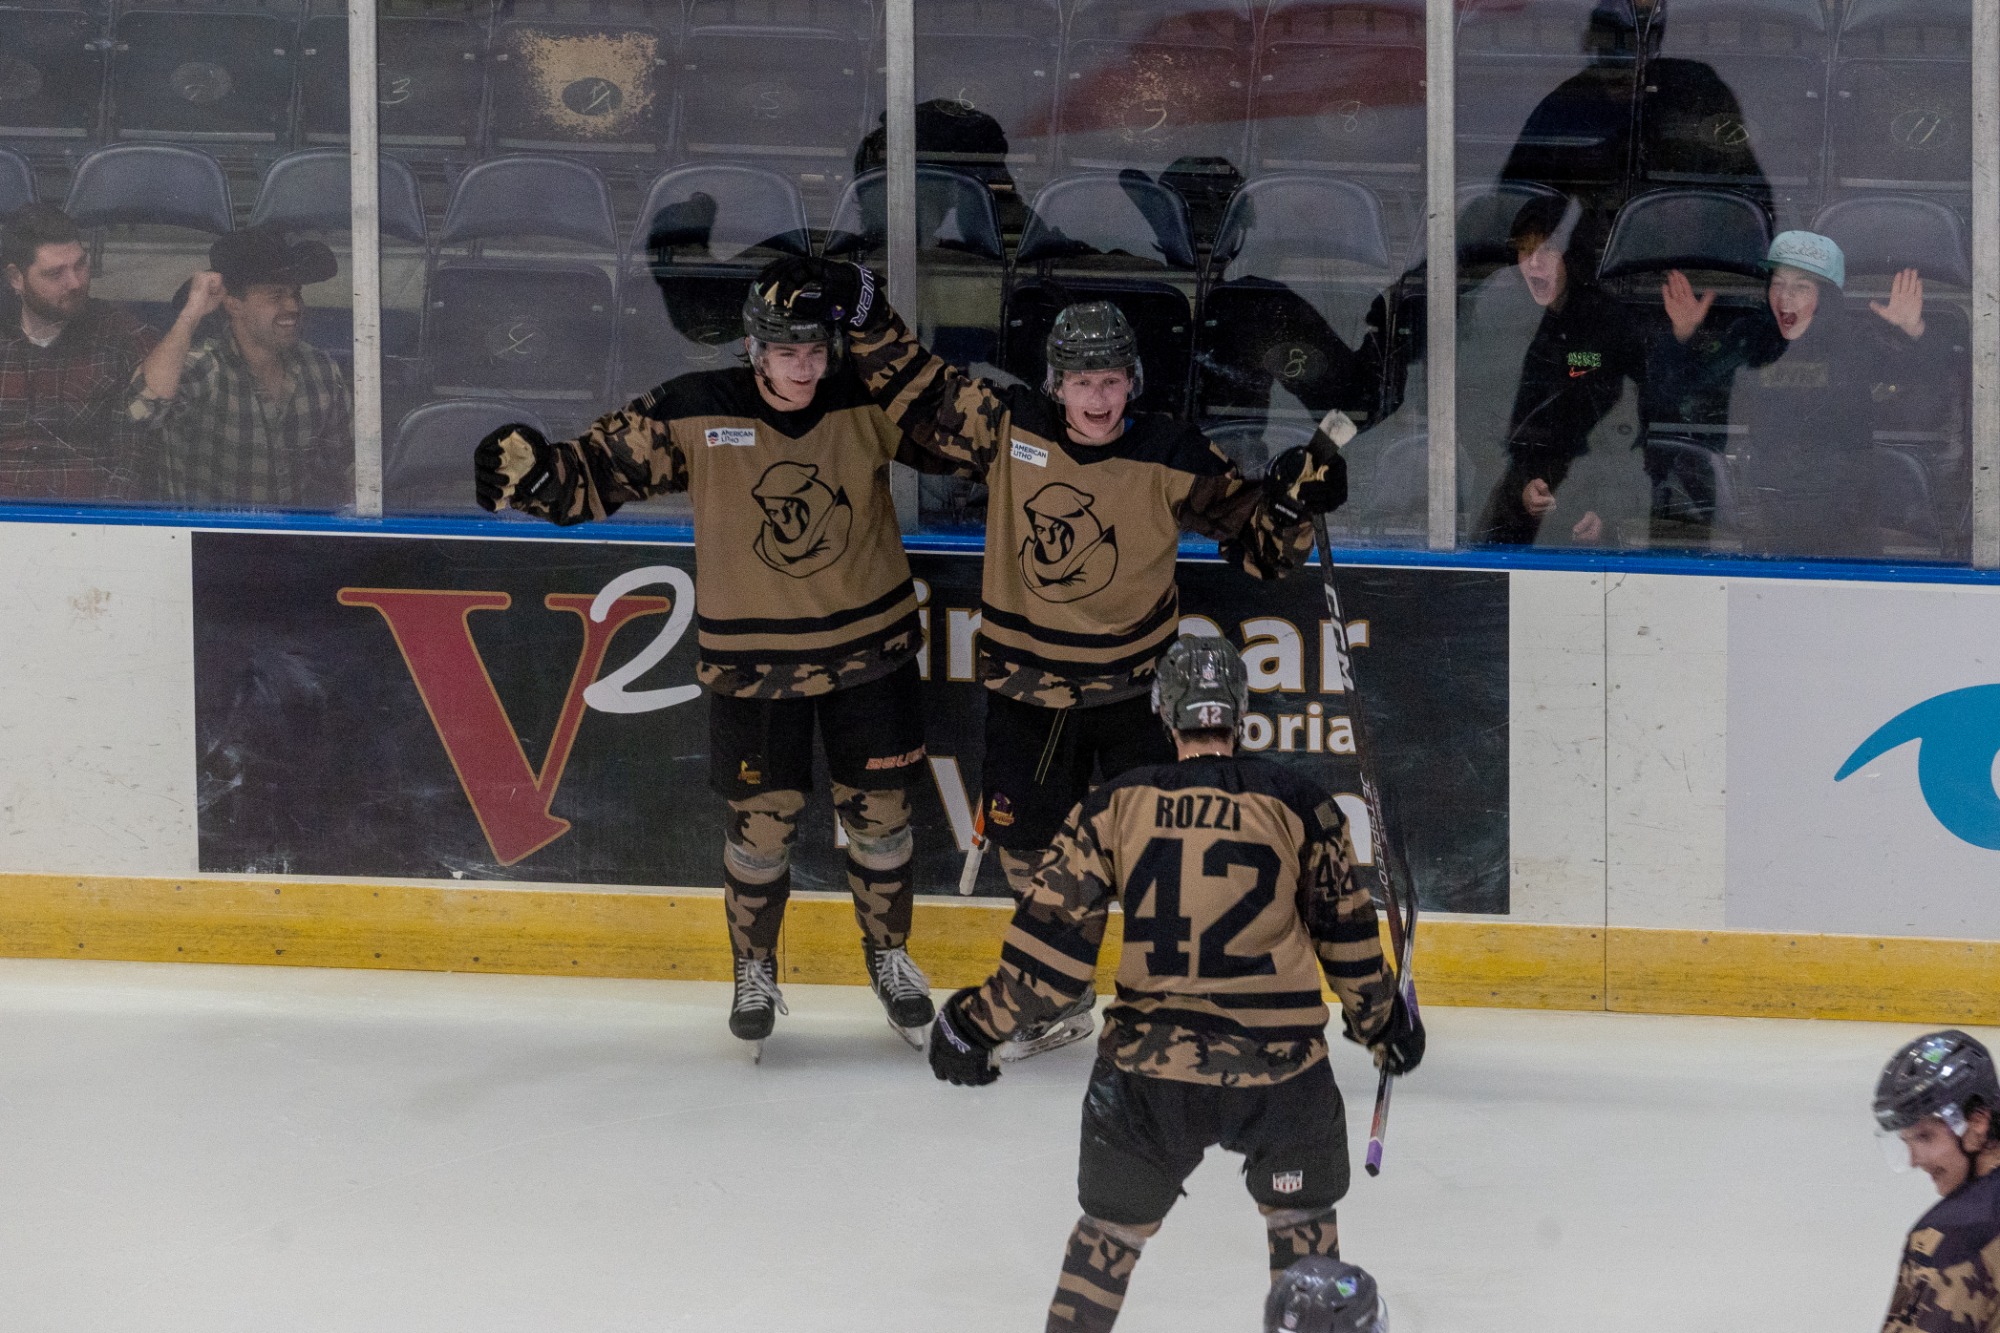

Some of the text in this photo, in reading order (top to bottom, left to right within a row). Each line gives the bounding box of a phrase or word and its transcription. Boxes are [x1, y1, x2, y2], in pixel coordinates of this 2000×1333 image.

[721, 430, 754, 438] AMERICAN
[1013, 450, 1032, 460] LITHO
[1014, 443, 1047, 459] AMERICAN
[1324, 582, 1355, 692] CCM
[1198, 705, 1222, 728] 42
[865, 743, 927, 770] BAUE
[1155, 795, 1241, 832] ROZZI
[1360, 771, 1390, 886] JETSPEED
[1123, 837, 1282, 979] 42
